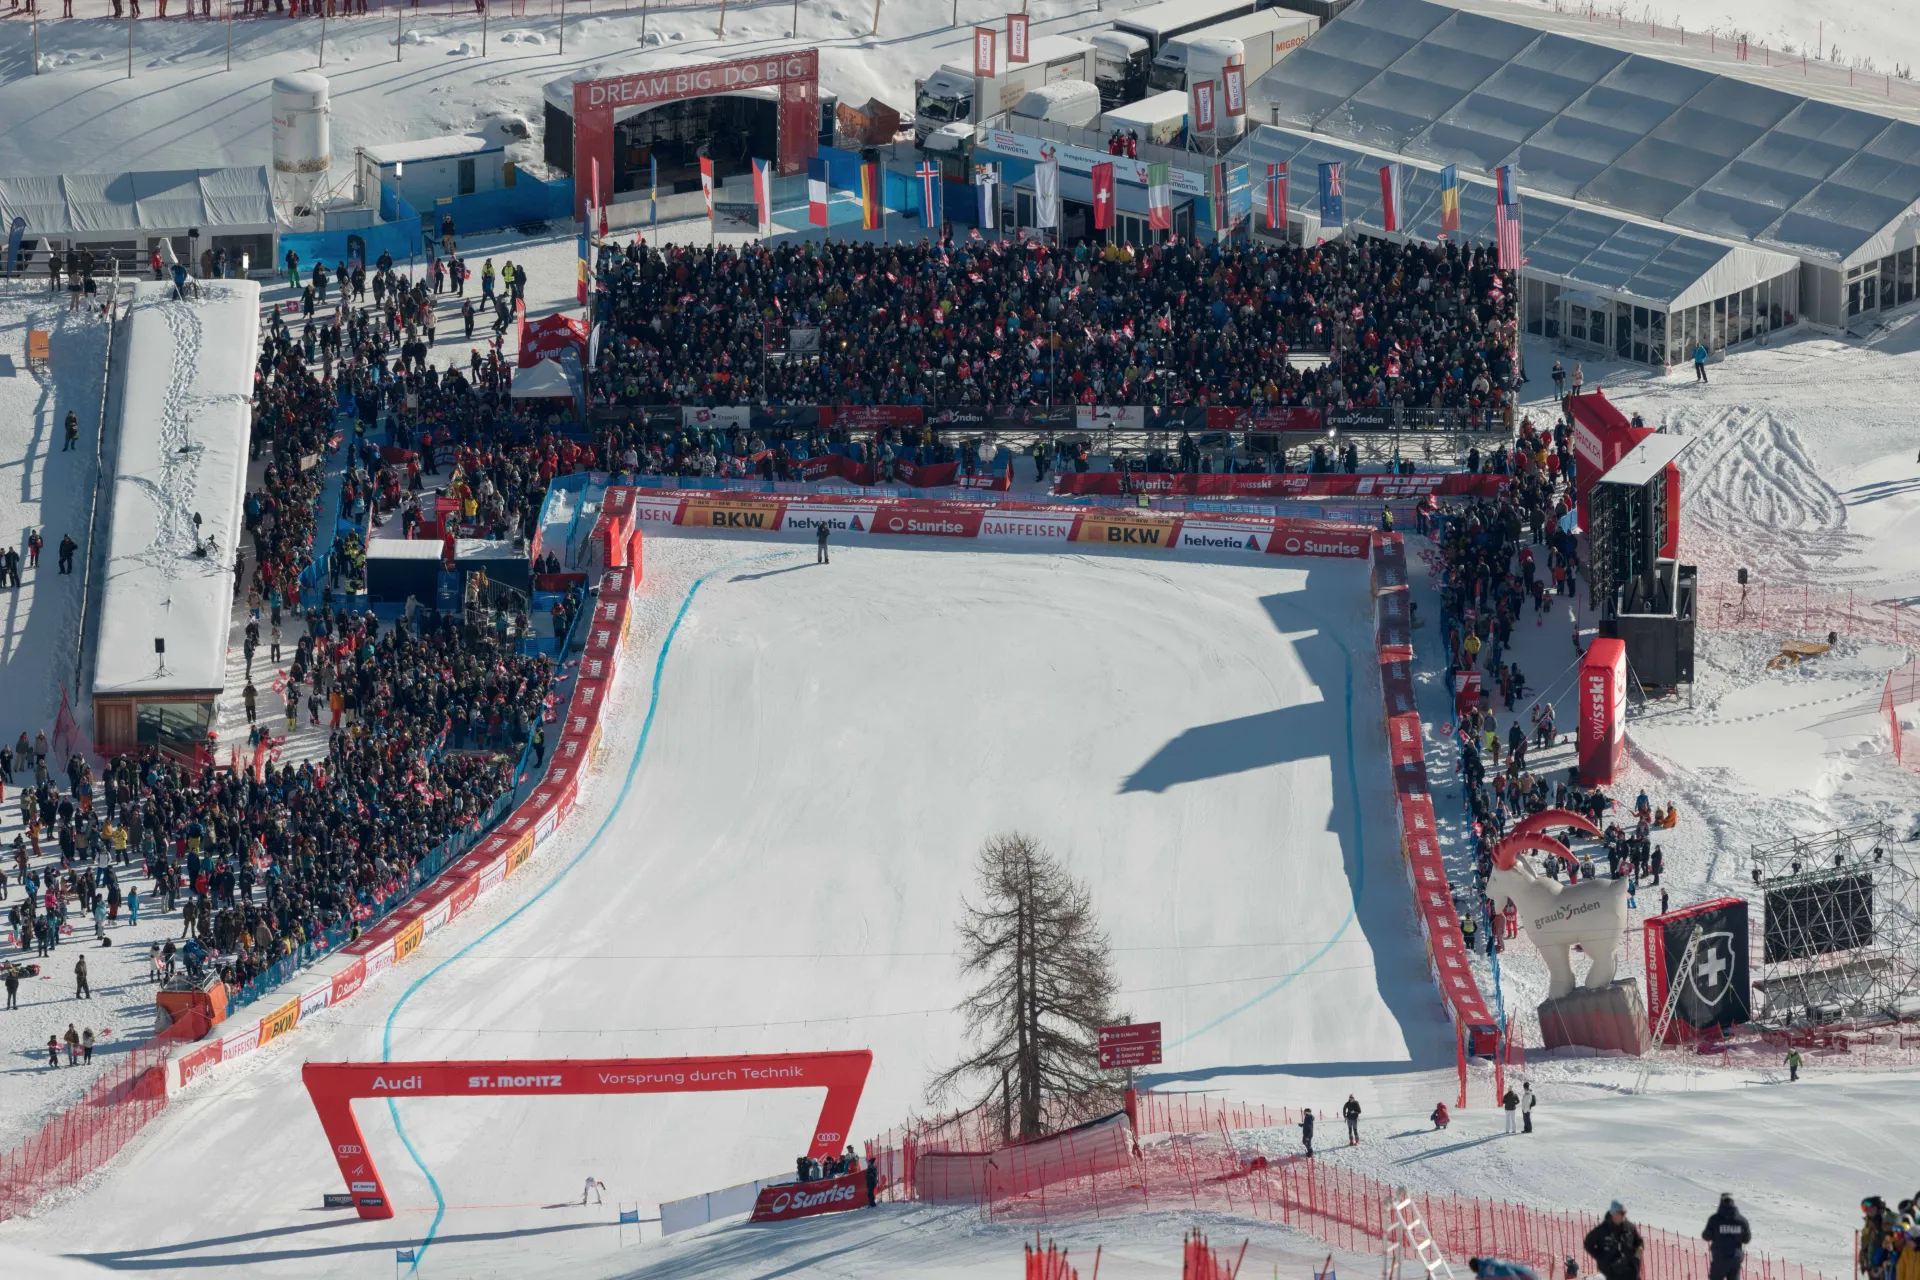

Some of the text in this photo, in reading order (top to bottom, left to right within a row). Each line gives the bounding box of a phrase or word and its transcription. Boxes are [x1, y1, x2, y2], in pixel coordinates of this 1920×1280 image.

[1276, 36, 1306, 52] MIGROS
[590, 58, 808, 106] DREAM BIG. DO BIG.
[997, 144, 1029, 155] ANTWORTEN
[1172, 182, 1199, 191] NTWORTEN
[536, 347, 562, 359] rivel
[712, 511, 765, 528] BKW
[788, 517, 847, 530] helvtia
[908, 520, 963, 534] Sunrise
[983, 522, 1066, 537] RAIFFEISEN
[1108, 527, 1160, 544] BKW
[1184, 534, 1242, 549] helvetia
[1304, 541, 1360, 555] Sunrise
[1589, 675, 1604, 741] swissski
[1648, 929, 1660, 1014] ARMÉE SUISSE
[271, 1013, 295, 1039] BKW
[192, 1057, 216, 1078] Sunrise
[372, 1076, 423, 1090] Audi
[598, 1070, 685, 1086] Vorsprung
[690, 1069, 737, 1082] durch
[741, 1066, 804, 1079] Technik
[790, 1184, 856, 1209] Sunrise
